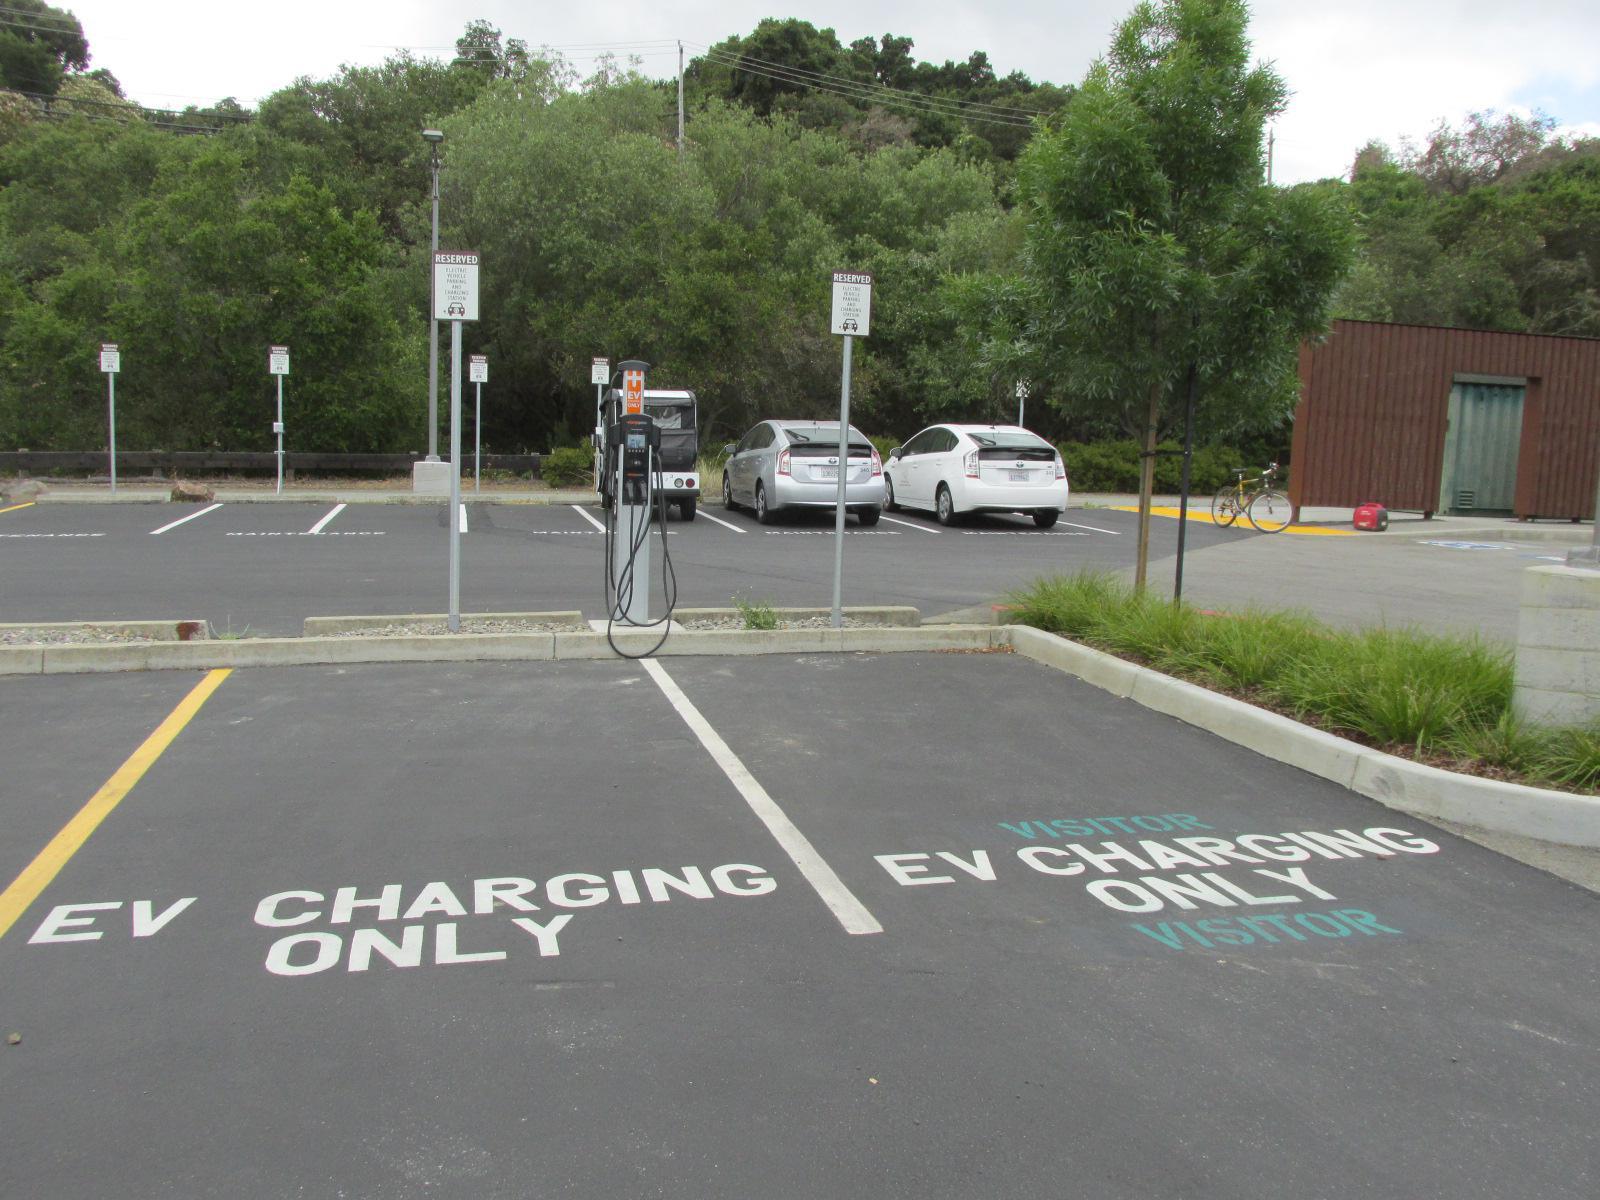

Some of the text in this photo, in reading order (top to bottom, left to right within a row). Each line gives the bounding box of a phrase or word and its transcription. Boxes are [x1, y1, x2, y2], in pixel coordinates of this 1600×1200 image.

[435, 254, 478, 264] RESERVED
[833, 273, 871, 283] RESERVED
[627, 391, 641, 400] EV
[998, 813, 1216, 840] VISITOR
[873, 827, 1441, 886] EV CHARGING
[27, 863, 778, 945] EV CHARGING
[1085, 867, 1338, 913] ONLY
[265, 914, 574, 976] ONLY
[1133, 908, 1404, 951] VISITOR
